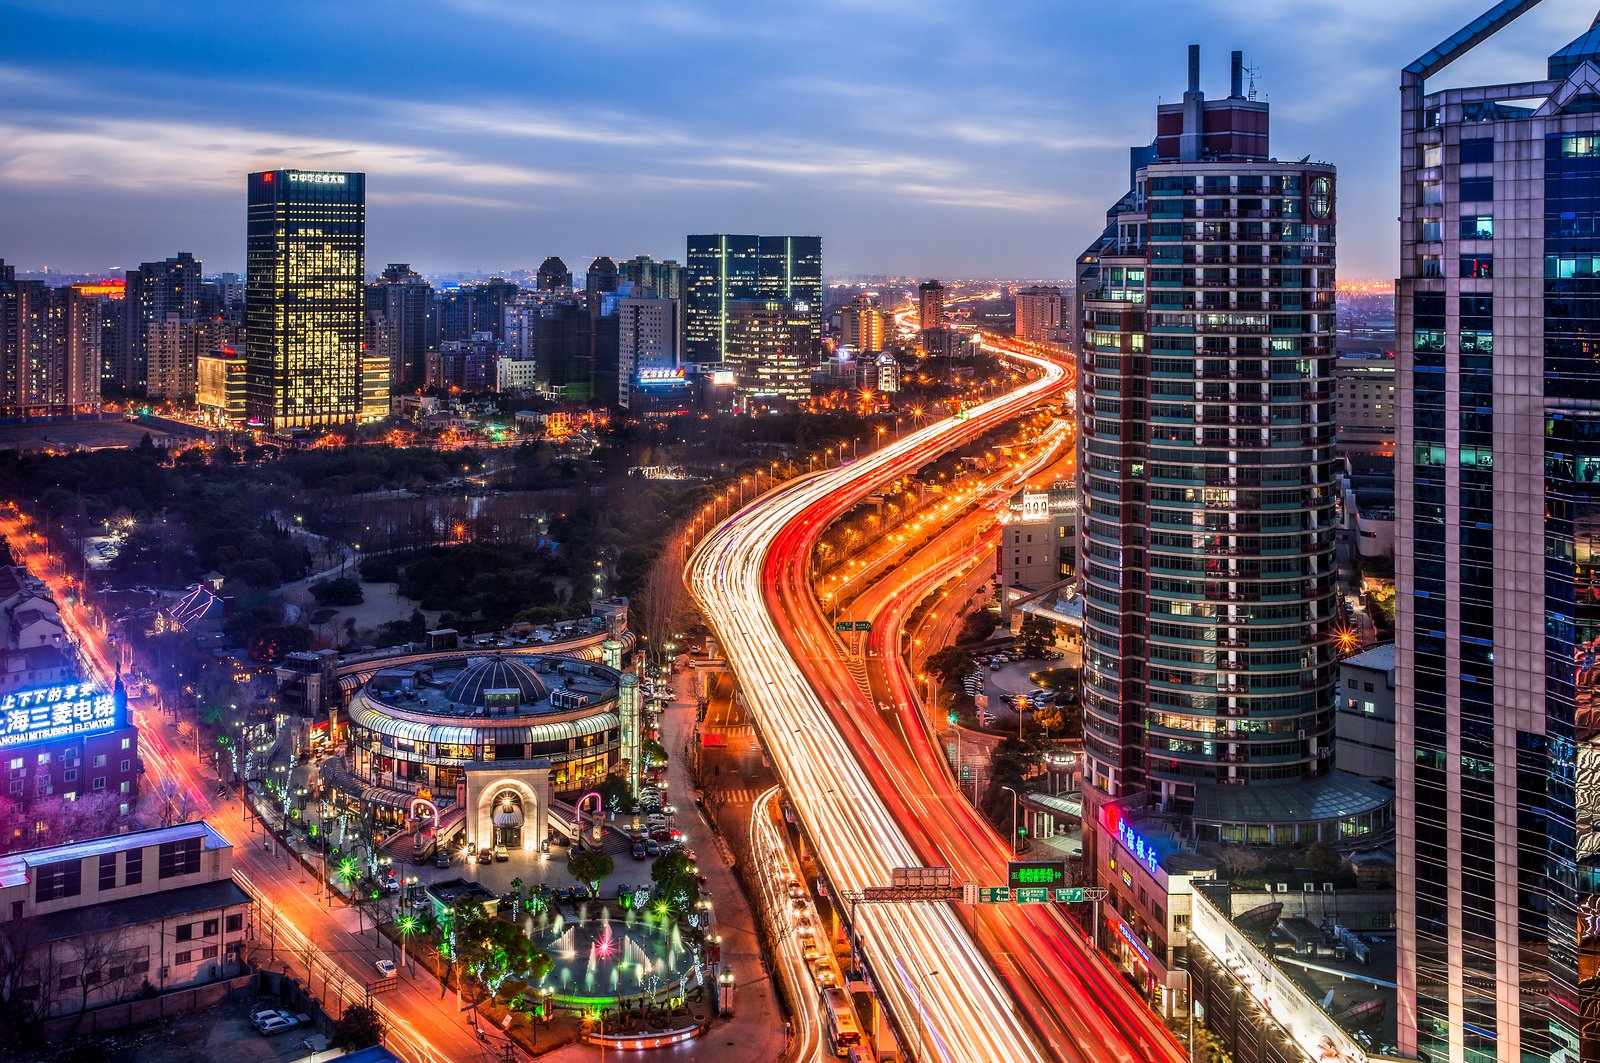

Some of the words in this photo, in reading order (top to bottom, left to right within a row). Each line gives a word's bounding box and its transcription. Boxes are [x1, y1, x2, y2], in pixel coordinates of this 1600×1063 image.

[1, 682, 95, 711] 上下下的享受
[29, 724, 73, 741] MITSUBISHI
[75, 717, 115, 732] ELEVATOR
[1118, 817, 1157, 873] 中信银行
